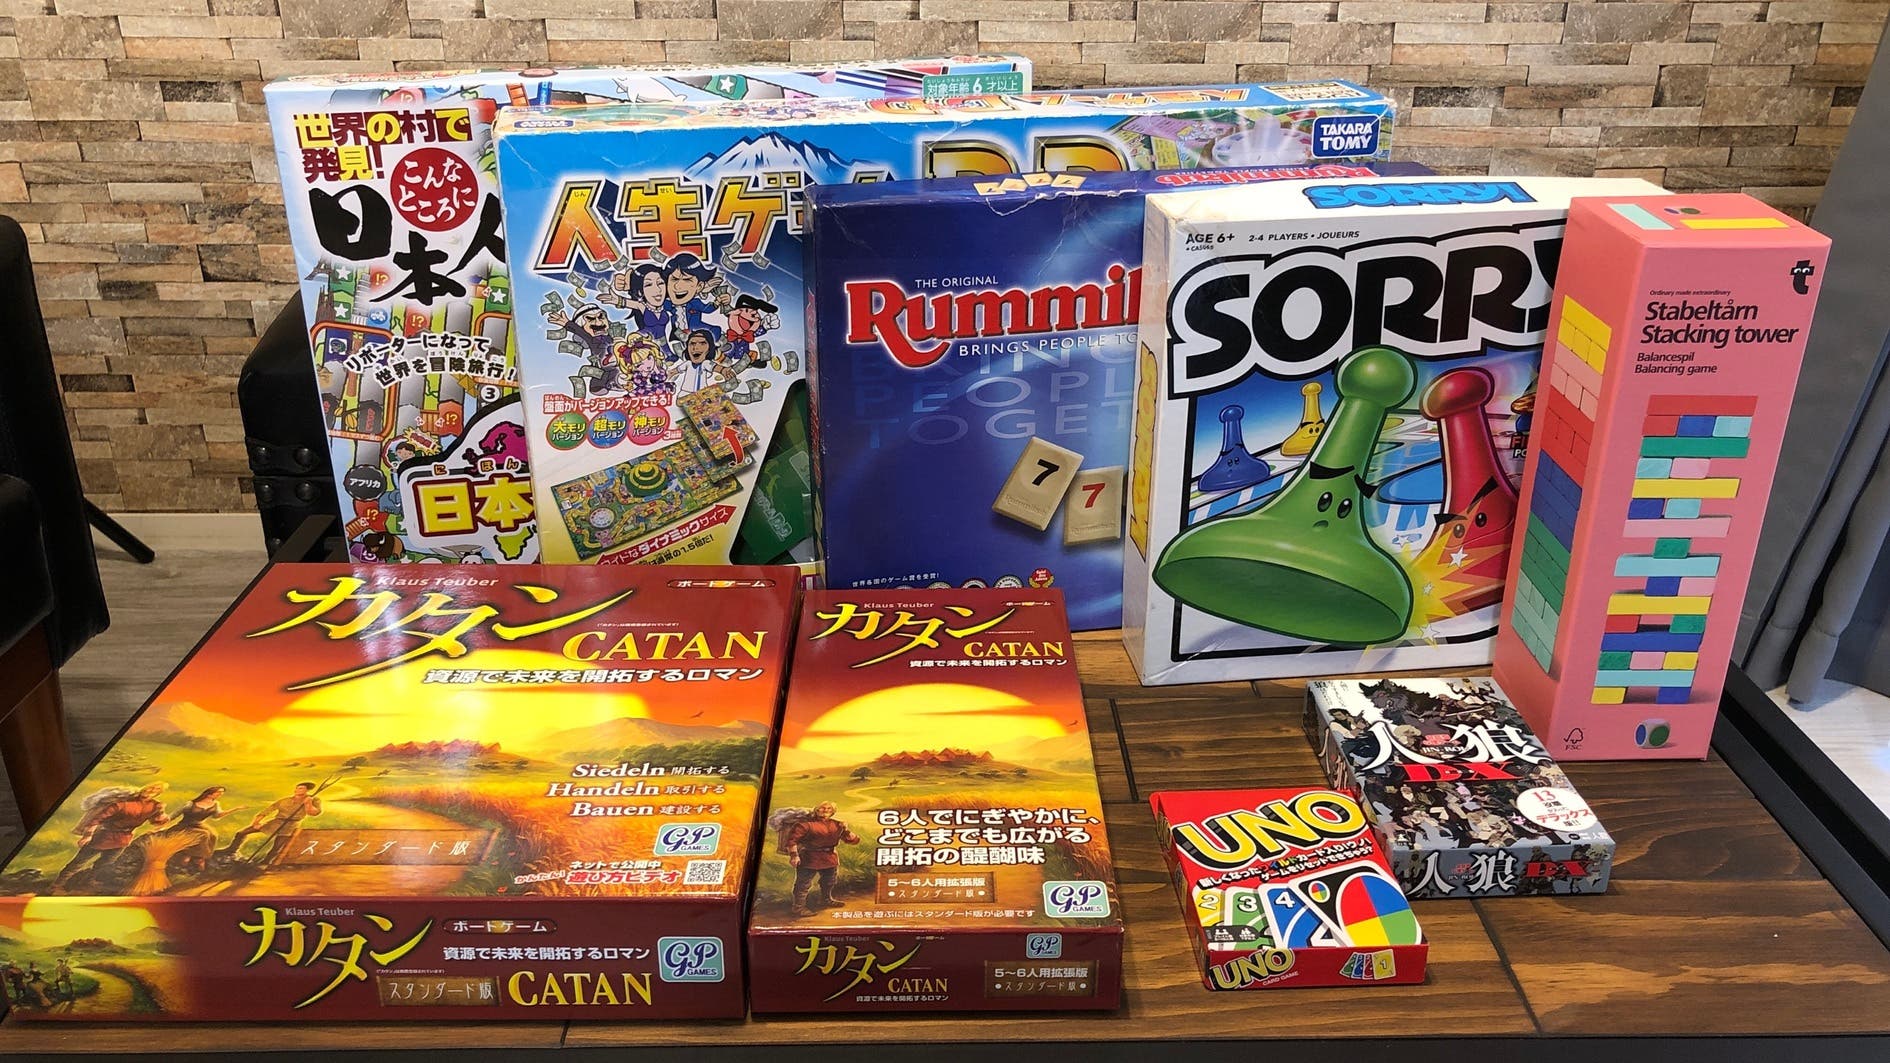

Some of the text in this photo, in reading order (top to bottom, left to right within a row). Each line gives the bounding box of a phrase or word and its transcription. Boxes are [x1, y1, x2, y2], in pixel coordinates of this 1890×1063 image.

[294, 108, 472, 148] 世界の村で
[1321, 122, 1373, 136] TAKARA
[1320, 135, 1372, 150] TOMY
[302, 144, 385, 183] 発見!
[403, 157, 463, 189] こんな
[398, 186, 476, 223] ところに
[1186, 234, 1214, 244] AGE
[1217, 233, 1235, 243] 6+
[1268, 233, 1308, 241] PLAYERS
[1317, 231, 1360, 239] JOUEURS
[915, 275, 998, 288] THE ORIGINAL
[1645, 299, 1758, 321] Stabeltårn
[959, 341, 1030, 356] BRINGS
[1039, 334, 1106, 350] PEOPLE
[1640, 324, 1799, 349] Stacking tower
[347, 333, 490, 371] リポーターになって
[1637, 352, 1695, 363] Balancespil
[375, 356, 515, 386] 世界を冒険旅行!
[1634, 364, 1718, 375] Balancing game
[544, 394, 670, 412] 盤面がバージョンアップできる!
[554, 421, 586, 432] 大モリ
[594, 418, 626, 431] 超モリ
[634, 416, 666, 428] 神モリ
[552, 433, 583, 441] バージョン
[593, 431, 623, 439] バージョン
[633, 428, 663, 436] バージョン
[434, 458, 519, 475] にほん
[1032, 459, 1060, 486] 7
[350, 477, 381, 489] アフリカ
[1082, 483, 1105, 508] 7
[377, 576, 500, 588] Klaus Teuber
[676, 578, 766, 589] ボードゲーム
[246, 577, 633, 690] カタン
[810, 603, 1014, 668] カタン
[561, 631, 768, 661] CATAN
[963, 641, 1064, 657] CATAN
[909, 659, 1068, 667] 資源で未来を開拓するロマン
[424, 668, 763, 684] 資源で未来を開拓するロマン
[1361, 719, 1554, 771] 人狼
[572, 763, 730, 778] Siedeln 開拓する
[1399, 762, 1528, 783] DX
[546, 782, 725, 797] Handeln 取引する
[570, 802, 721, 817] Bauen 建設する
[877, 808, 1102, 826] 6人でにぎやかに、
[1536, 809, 1593, 823] デラックス
[877, 827, 1091, 845] どこまでも広がる
[1174, 791, 1366, 869] UNO
[662, 826, 715, 852] GP
[300, 839, 473, 857] スタンダード版
[876, 847, 1046, 866] 開拓の醍醐味
[569, 861, 661, 870] ネットで公開中
[1410, 850, 1518, 894] 人狼
[514, 869, 565, 884] かんたん!
[566, 870, 682, 884] 遊び方ビデオ
[898, 889, 975, 898] スタンダード版
[1050, 886, 1101, 913] GP
[1198, 893, 1220, 911] 2
[1275, 891, 1295, 908] 4
[285, 907, 355, 916] Klaus Teuber
[1238, 895, 1257, 912] 3
[831, 910, 1035, 918] 本製品を遊ぶにはスタンダード版が必要です
[453, 920, 548, 933] ボードゲーム
[239, 906, 433, 1009] カタン
[443, 947, 651, 960] 資源で未来を開拓するロマン
[664, 939, 717, 975] GP
[687, 968, 717, 976] GAMES
[795, 937, 921, 1001] カタン
[1210, 948, 1294, 990] UNO
[888, 978, 948, 993] CATAN
[1006, 982, 1077, 991] スタンダード版
[1263, 972, 1299, 986] CARD GAME
[388, 982, 493, 999] スタンダード版
[509, 971, 653, 1007] CATAN
